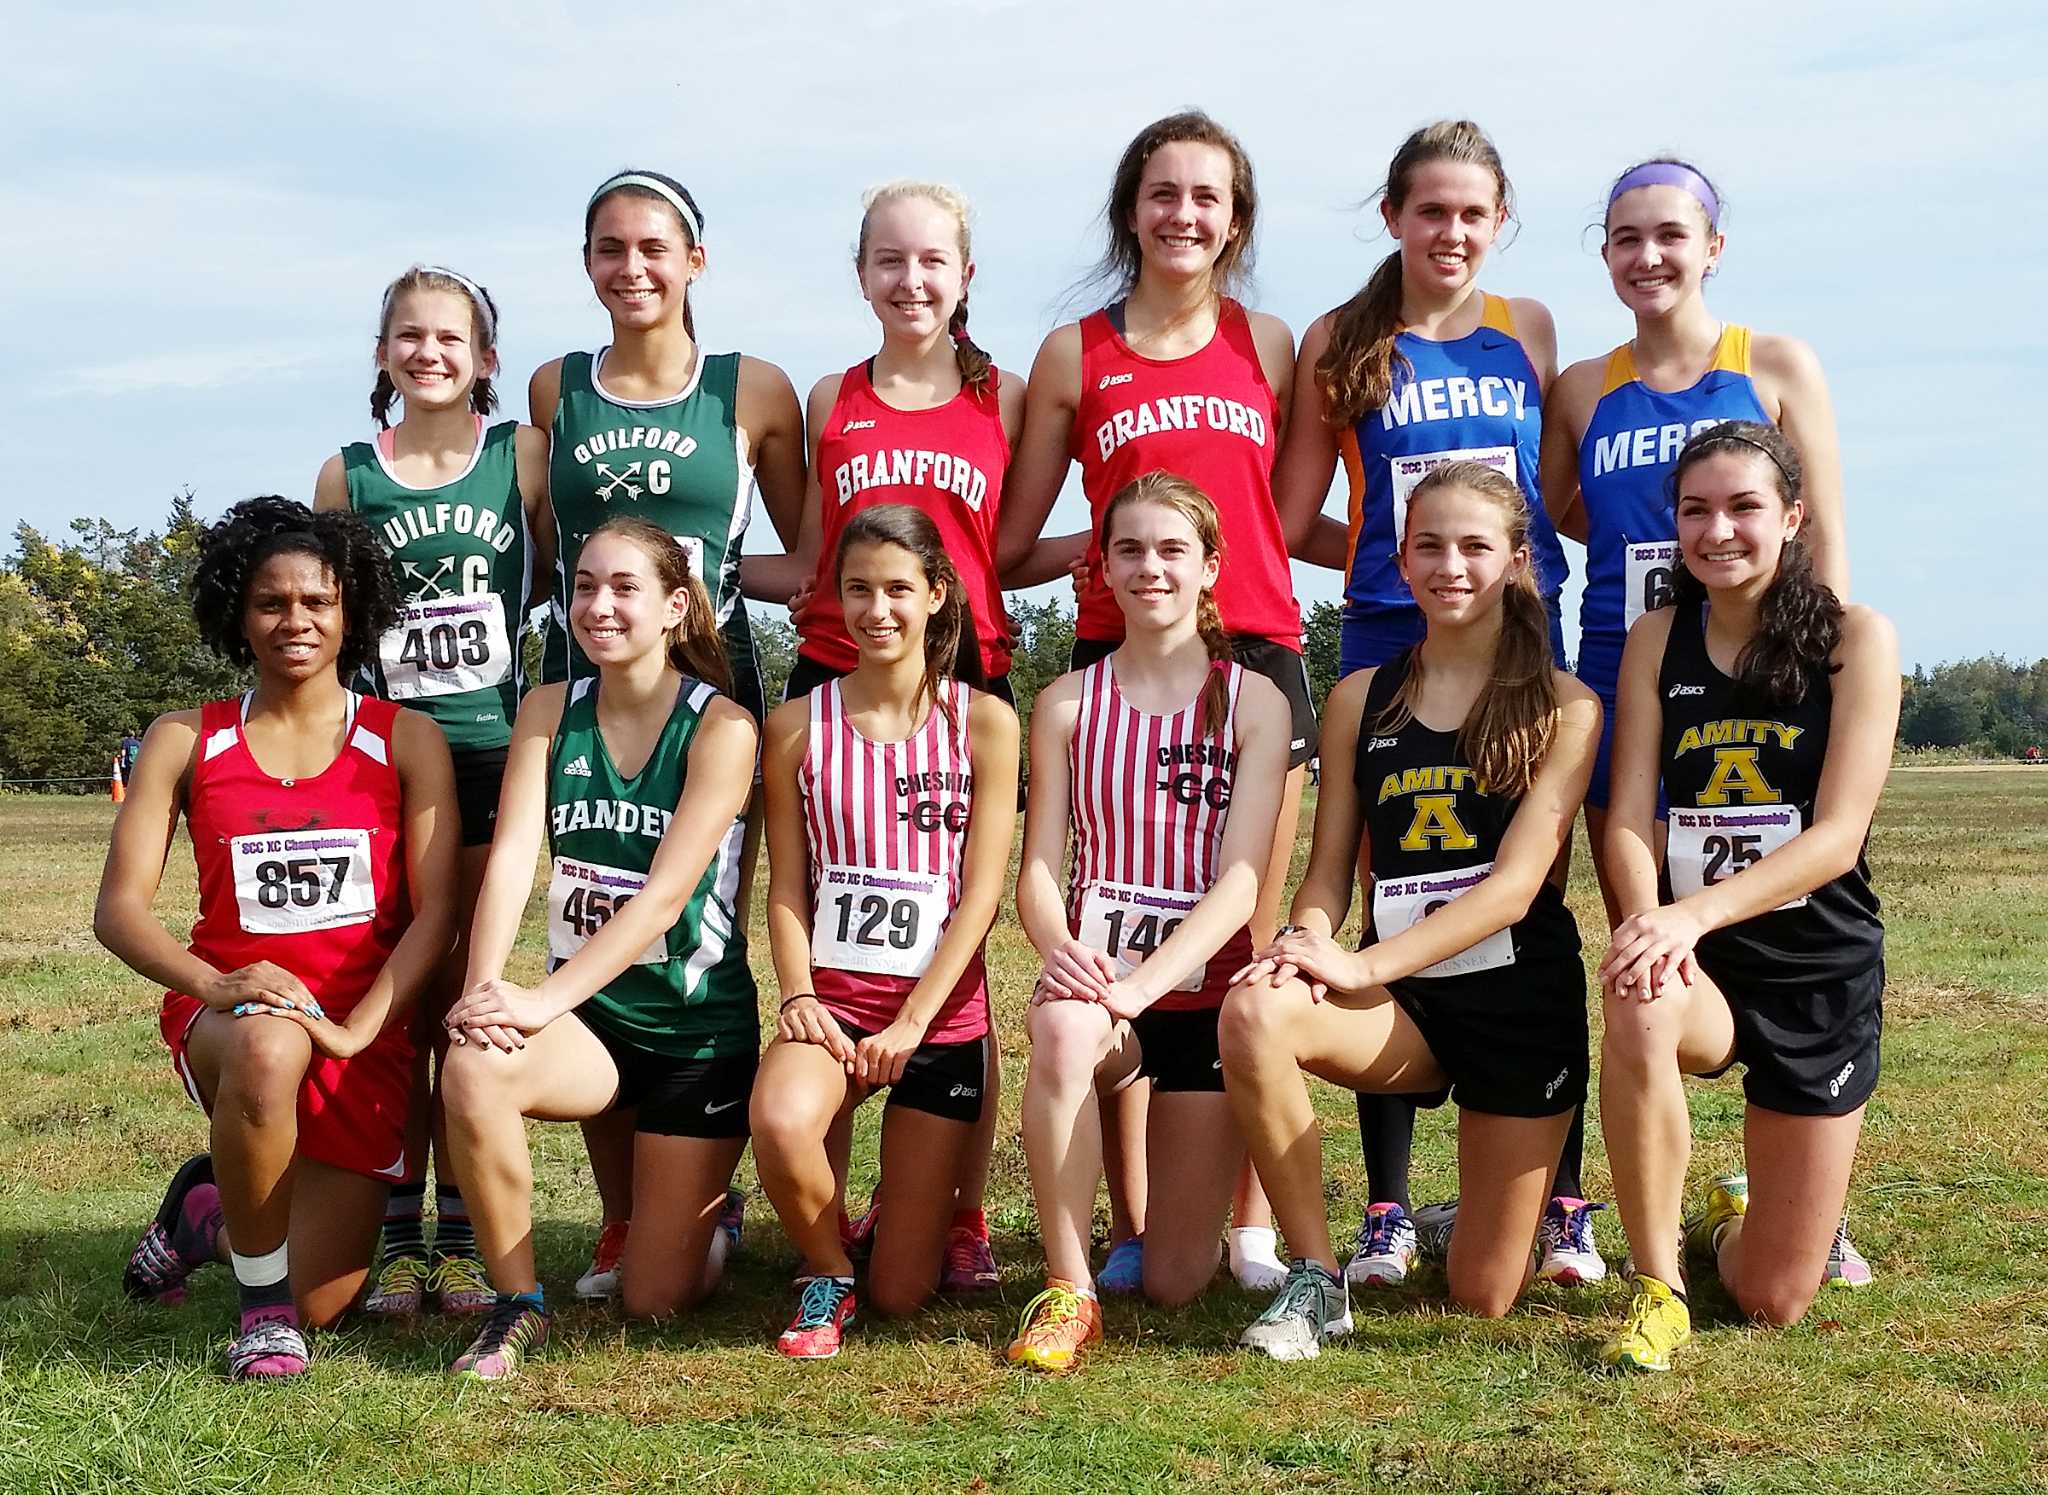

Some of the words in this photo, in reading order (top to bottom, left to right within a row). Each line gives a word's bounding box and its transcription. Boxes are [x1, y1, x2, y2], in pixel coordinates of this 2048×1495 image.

[1380, 375, 1526, 432] MERCY
[573, 426, 698, 465] GUILFORD
[1096, 394, 1266, 462] BRANFORD
[1593, 418, 1731, 477] MER
[648, 459, 671, 495] C
[835, 449, 987, 511] BRANFORD
[462, 554, 489, 596] C
[1634, 548, 1656, 561] SCC
[399, 619, 490, 672] 403
[1674, 718, 1805, 760] AMITY
[563, 767, 593, 778] adidas
[1695, 746, 1782, 806] A
[1400, 793, 1478, 851] A
[1679, 815, 1696, 827] SCC
[1698, 816, 1712, 827] XC
[1713, 813, 1790, 828] Championship
[241, 841, 264, 855] SCC
[266, 840, 282, 853] XC
[284, 835, 360, 852] Championship
[1702, 834, 1763, 887] 25
[255, 856, 351, 909] 857
[562, 863, 577, 877] SCC
[578, 866, 589, 881] XC
[829, 871, 846, 884] SCC
[847, 873, 861, 885] XC
[863, 875, 933, 895] Championship
[1384, 885, 1402, 897] SCC
[1405, 882, 1418, 895] XC
[1099, 886, 1116, 900] SCC
[1118, 889, 1132, 903] XC
[835, 893, 919, 949] 129
